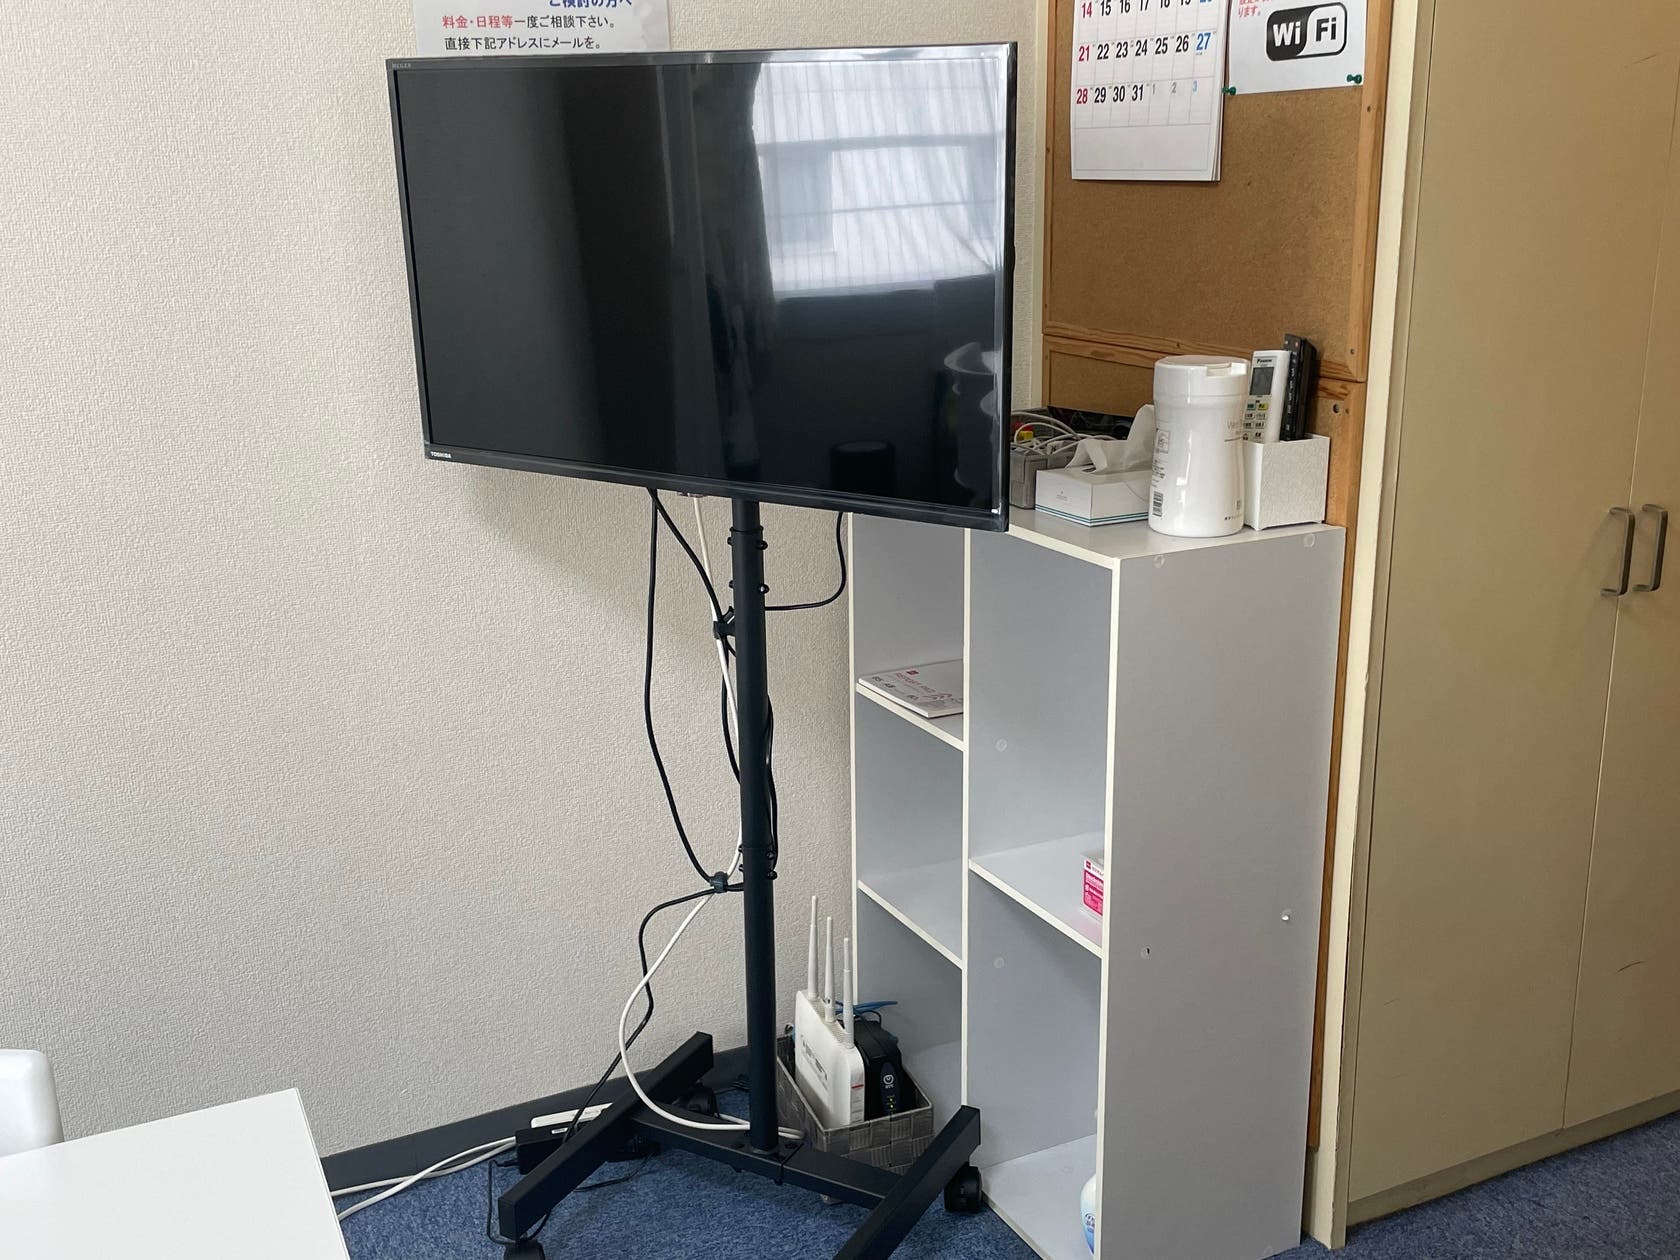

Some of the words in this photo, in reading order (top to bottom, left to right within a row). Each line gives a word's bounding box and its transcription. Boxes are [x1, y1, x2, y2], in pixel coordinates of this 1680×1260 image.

[1081, 3, 1092, 18] 14
[1100, 0, 1112, 16] 15
[1119, 0, 1131, 13] 16
[1140, 0, 1150, 11] 17
[444, 36, 601, 50] 直接下記アドレスにメールを。
[1272, 21, 1301, 47] Wi
[1315, 17, 1337, 42] Fi
[1078, 46, 1090, 62] 21
[1096, 44, 1109, 60] 22
[1115, 41, 1129, 58] 23
[1135, 39, 1148, 57] 24
[1155, 37, 1168, 54] 25
[1175, 35, 1189, 52] 26
[1196, 32, 1211, 50] 27
[1076, 88, 1088, 104] 28
[1094, 87, 1107, 103] 29
[1112, 86, 1126, 102] 30
[1131, 84, 1144, 101] 31
[1152, 84, 1155, 95] 1
[1171, 82, 1176, 93] 2
[1192, 81, 1198, 92] 3
